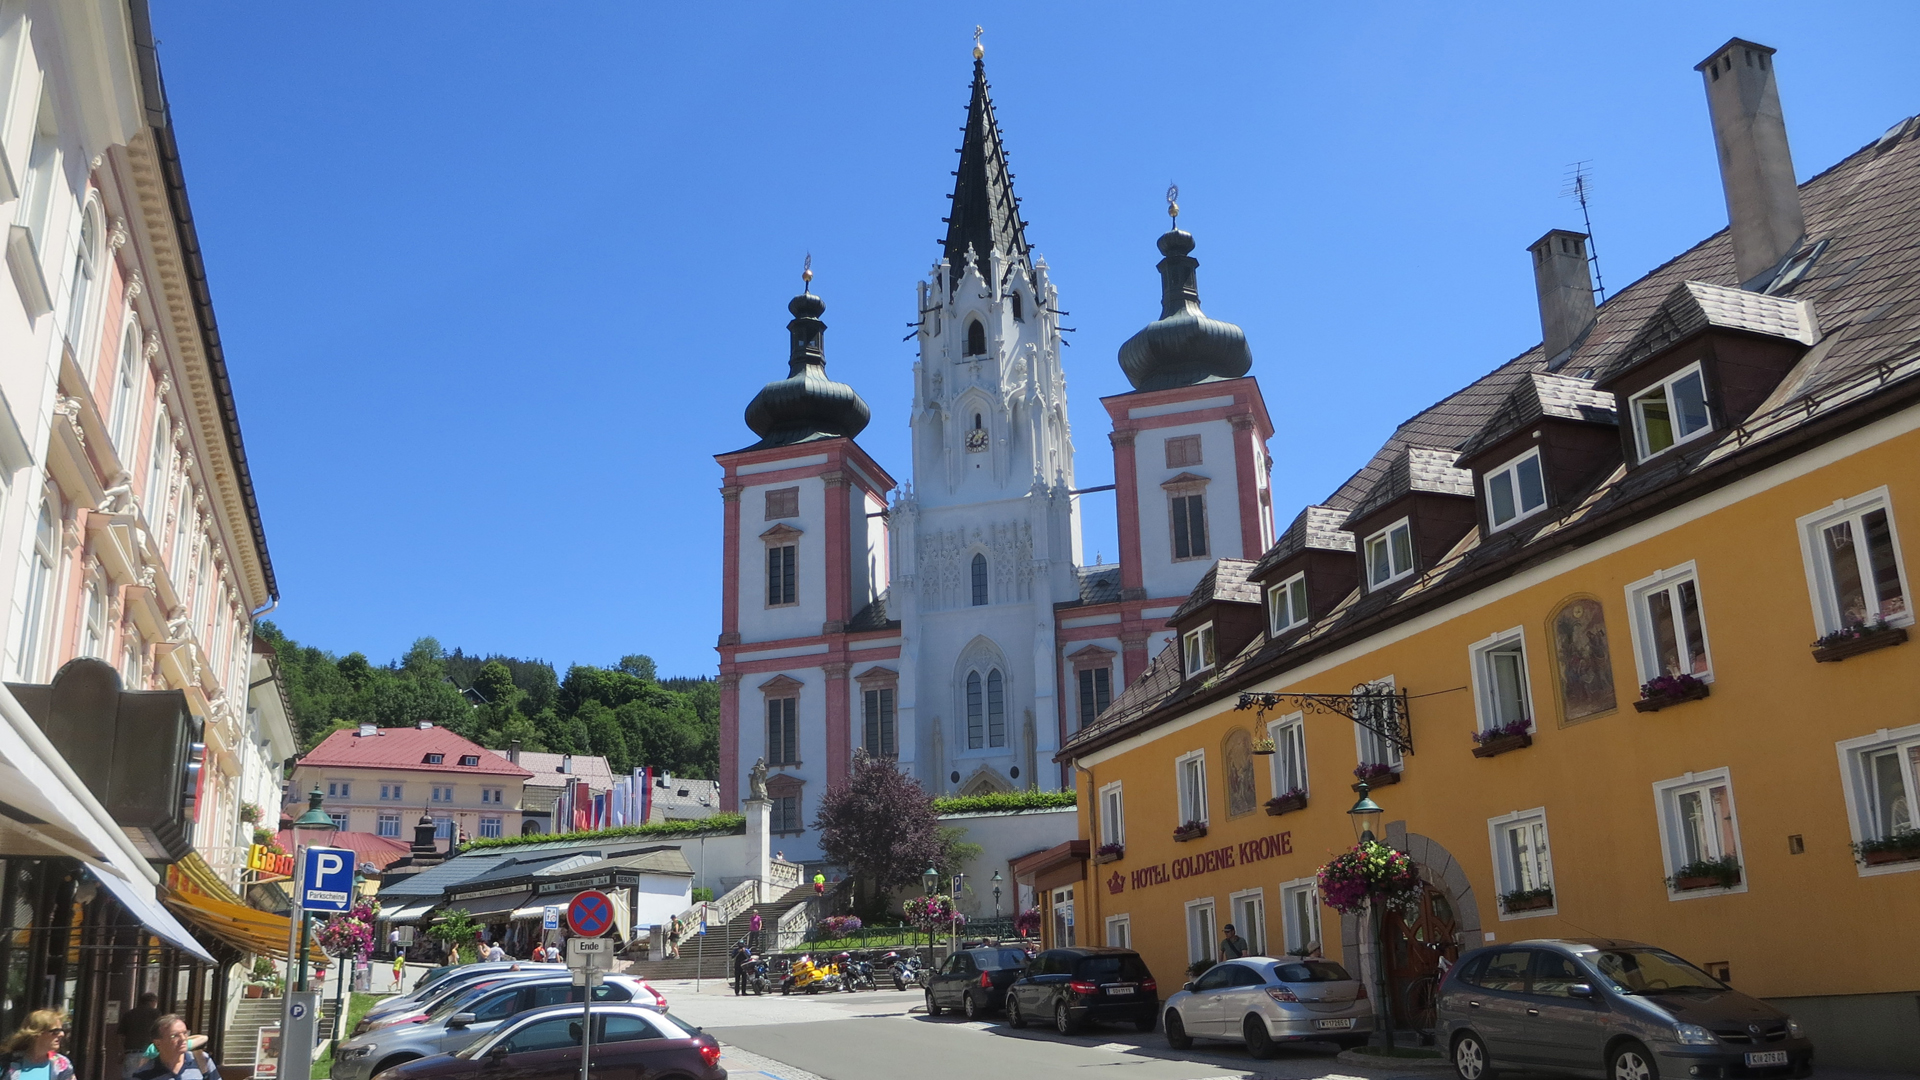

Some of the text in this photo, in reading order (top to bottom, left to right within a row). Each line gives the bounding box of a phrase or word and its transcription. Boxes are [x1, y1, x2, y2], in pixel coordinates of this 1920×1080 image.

[1131, 831, 1293, 890] HOTEL GOLDENE KRONE
[315, 853, 343, 888] P
[309, 891, 346, 901] Parkscheine
[580, 942, 599, 951] Ende
[293, 1006, 302, 1015] P
